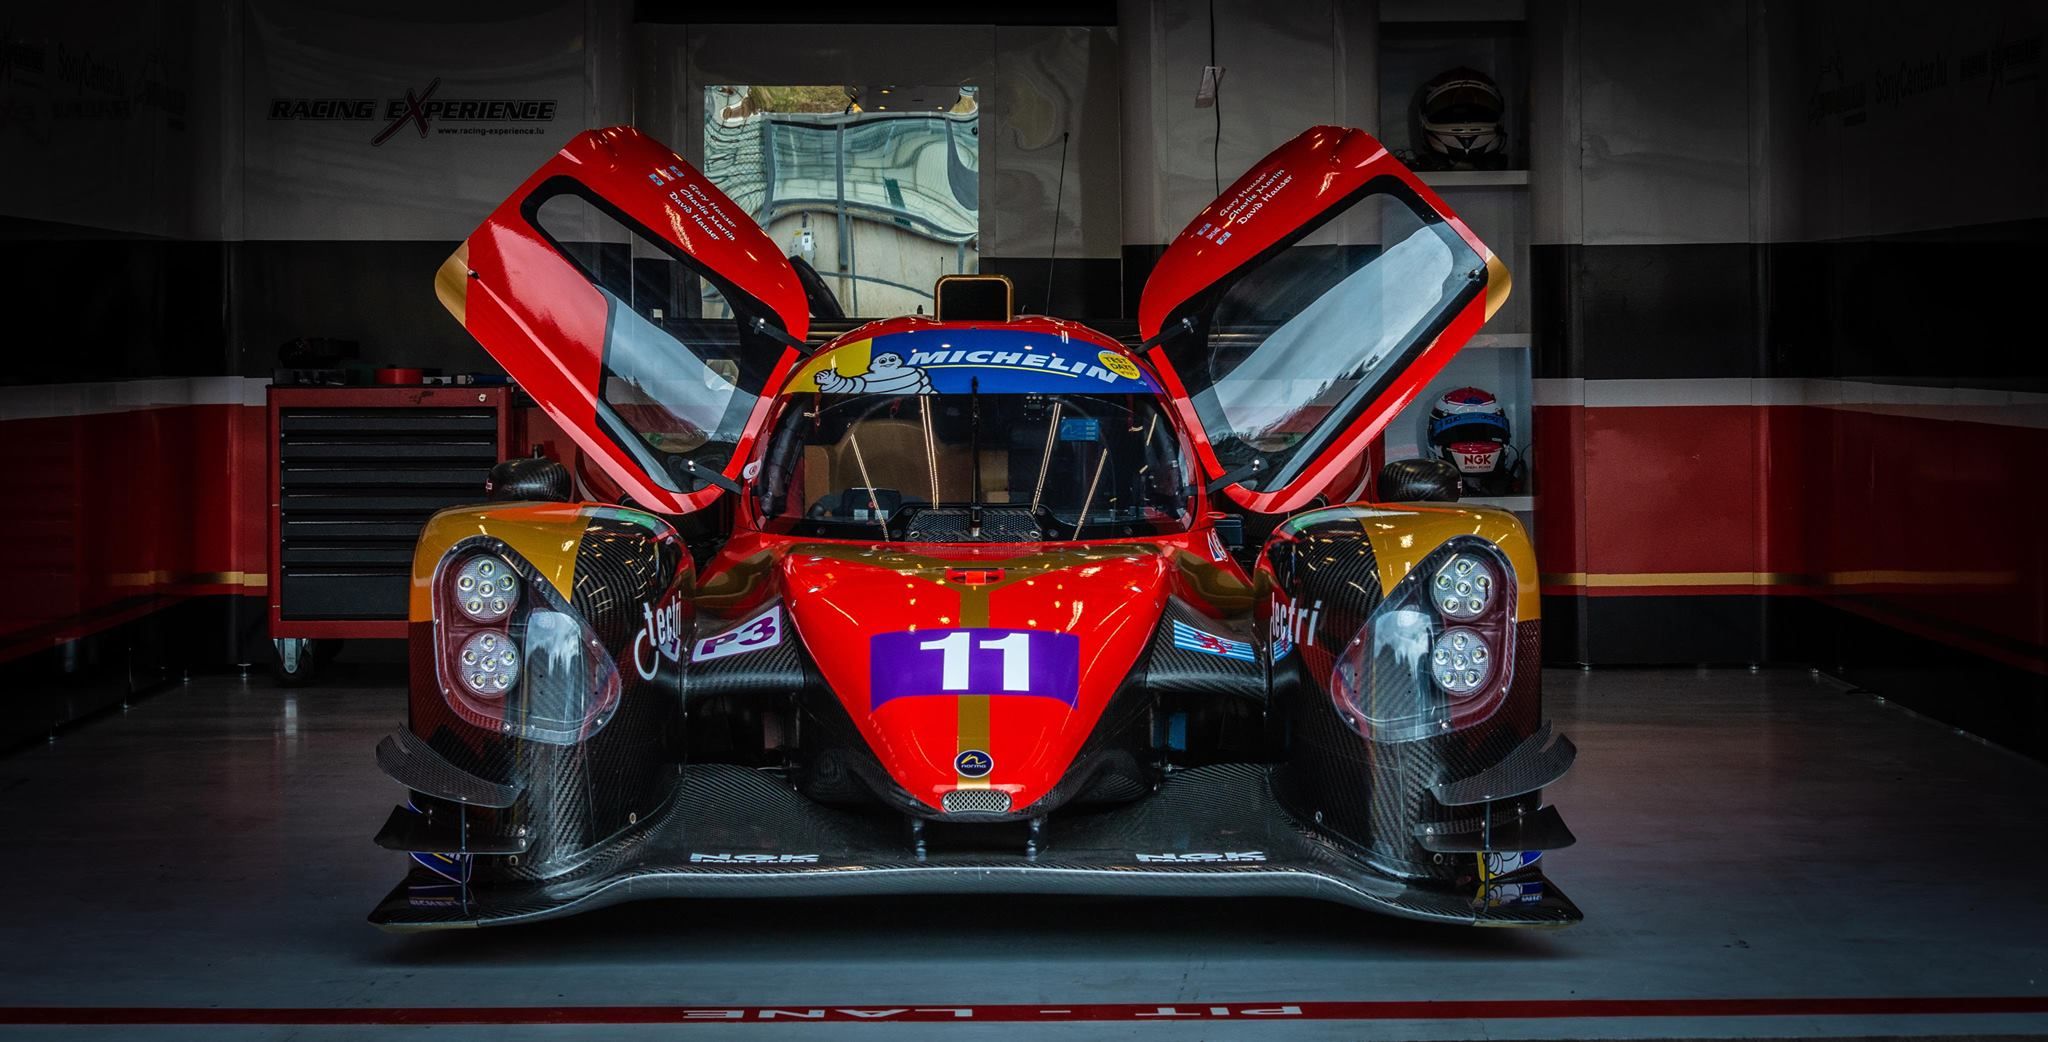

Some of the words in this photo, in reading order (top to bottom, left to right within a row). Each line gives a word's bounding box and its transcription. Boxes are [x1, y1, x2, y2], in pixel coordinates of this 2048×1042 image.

[268, 99, 376, 120] RACING
[438, 126, 545, 136] www.racing-experience.lu
[689, 184, 709, 201] Gary
[709, 202, 737, 228] Hauser
[1219, 198, 1240, 217] Gary
[1238, 173, 1267, 198] Hauser
[1228, 194, 1258, 221] Charlie
[1256, 169, 1285, 194] Martin
[1236, 202, 1263, 225] David
[1261, 174, 1293, 202] Hauser
[669, 191, 693, 214] David
[692, 213, 720, 241] Hauser
[680, 189, 710, 215] Charlie
[708, 215, 736, 241] Martin
[908, 350, 1119, 384] MICHELIN
[1465, 455, 1491, 465] NGK
[701, 617, 776, 655] P3
[920, 632, 1030, 691] 11
[689, 853, 820, 862] NGK
[1135, 851, 1267, 862] NGK
[682, 1008, 973, 1018] LANE
[1135, 1006, 1303, 1017] PIT
